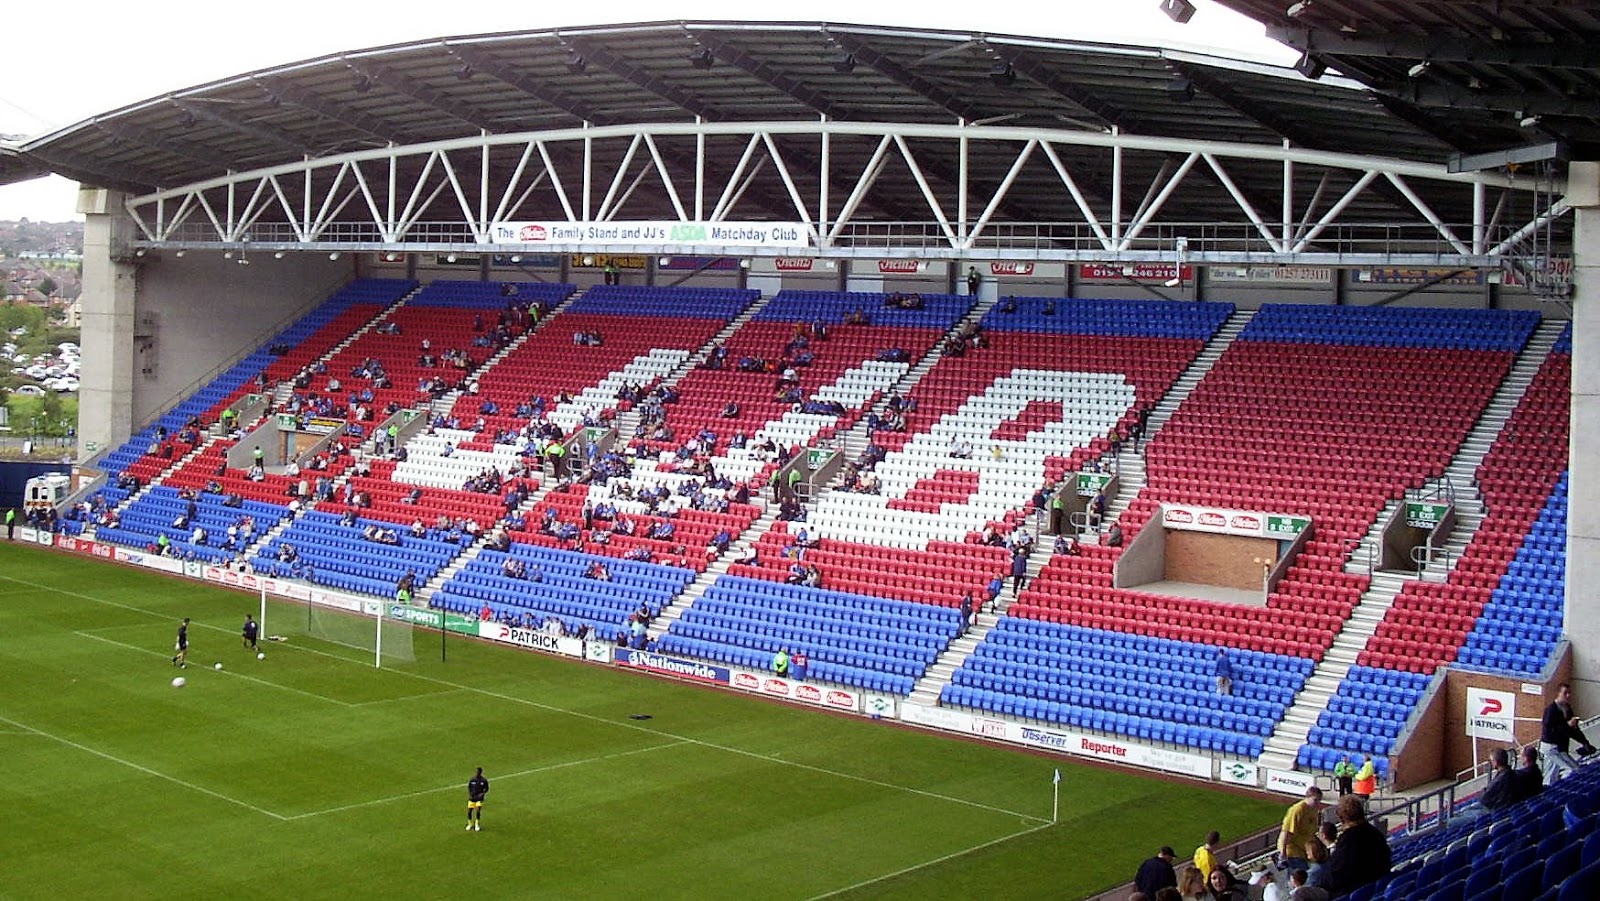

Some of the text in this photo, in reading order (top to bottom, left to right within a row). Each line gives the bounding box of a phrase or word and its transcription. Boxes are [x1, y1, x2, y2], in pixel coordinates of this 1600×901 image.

[497, 227, 514, 239] The
[552, 227, 585, 242] Family
[588, 226, 618, 240] Stand
[621, 226, 642, 239] and
[643, 226, 665, 240] JJ's
[670, 225, 707, 241] ASDA
[711, 227, 767, 242] Matchday
[772, 227, 798, 241] Club
[405, 609, 439, 626] SPORTS
[511, 629, 559, 650] PATRICK
[637, 651, 717, 680] Nationwide
[1021, 730, 1127, 757] Observer Reporter
